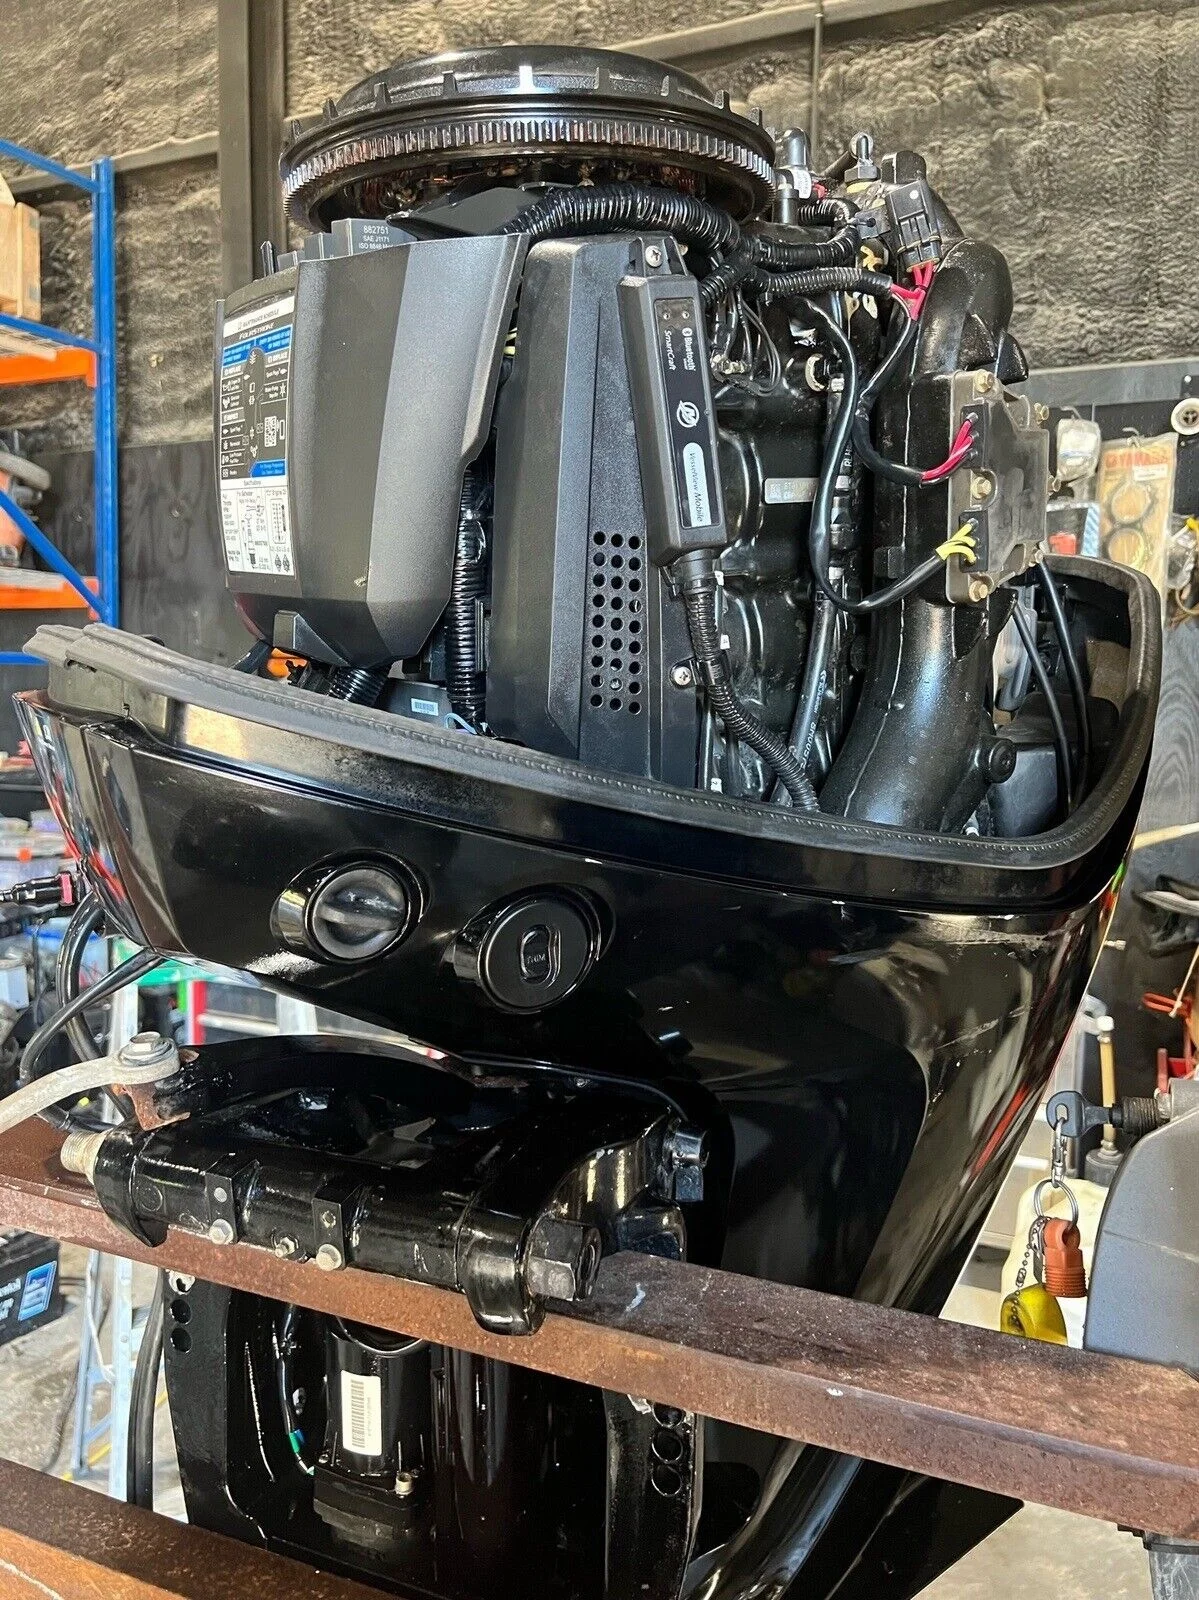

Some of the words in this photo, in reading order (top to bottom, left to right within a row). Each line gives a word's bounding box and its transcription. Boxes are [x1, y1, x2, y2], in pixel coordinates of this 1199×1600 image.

[664, 330, 677, 371] SmartCraft
[684, 337, 697, 371] Bluetooth
[689, 452, 699, 491] VesselView
[694, 493, 703, 522] Mobile
[526, 953, 546, 964] TRIM
